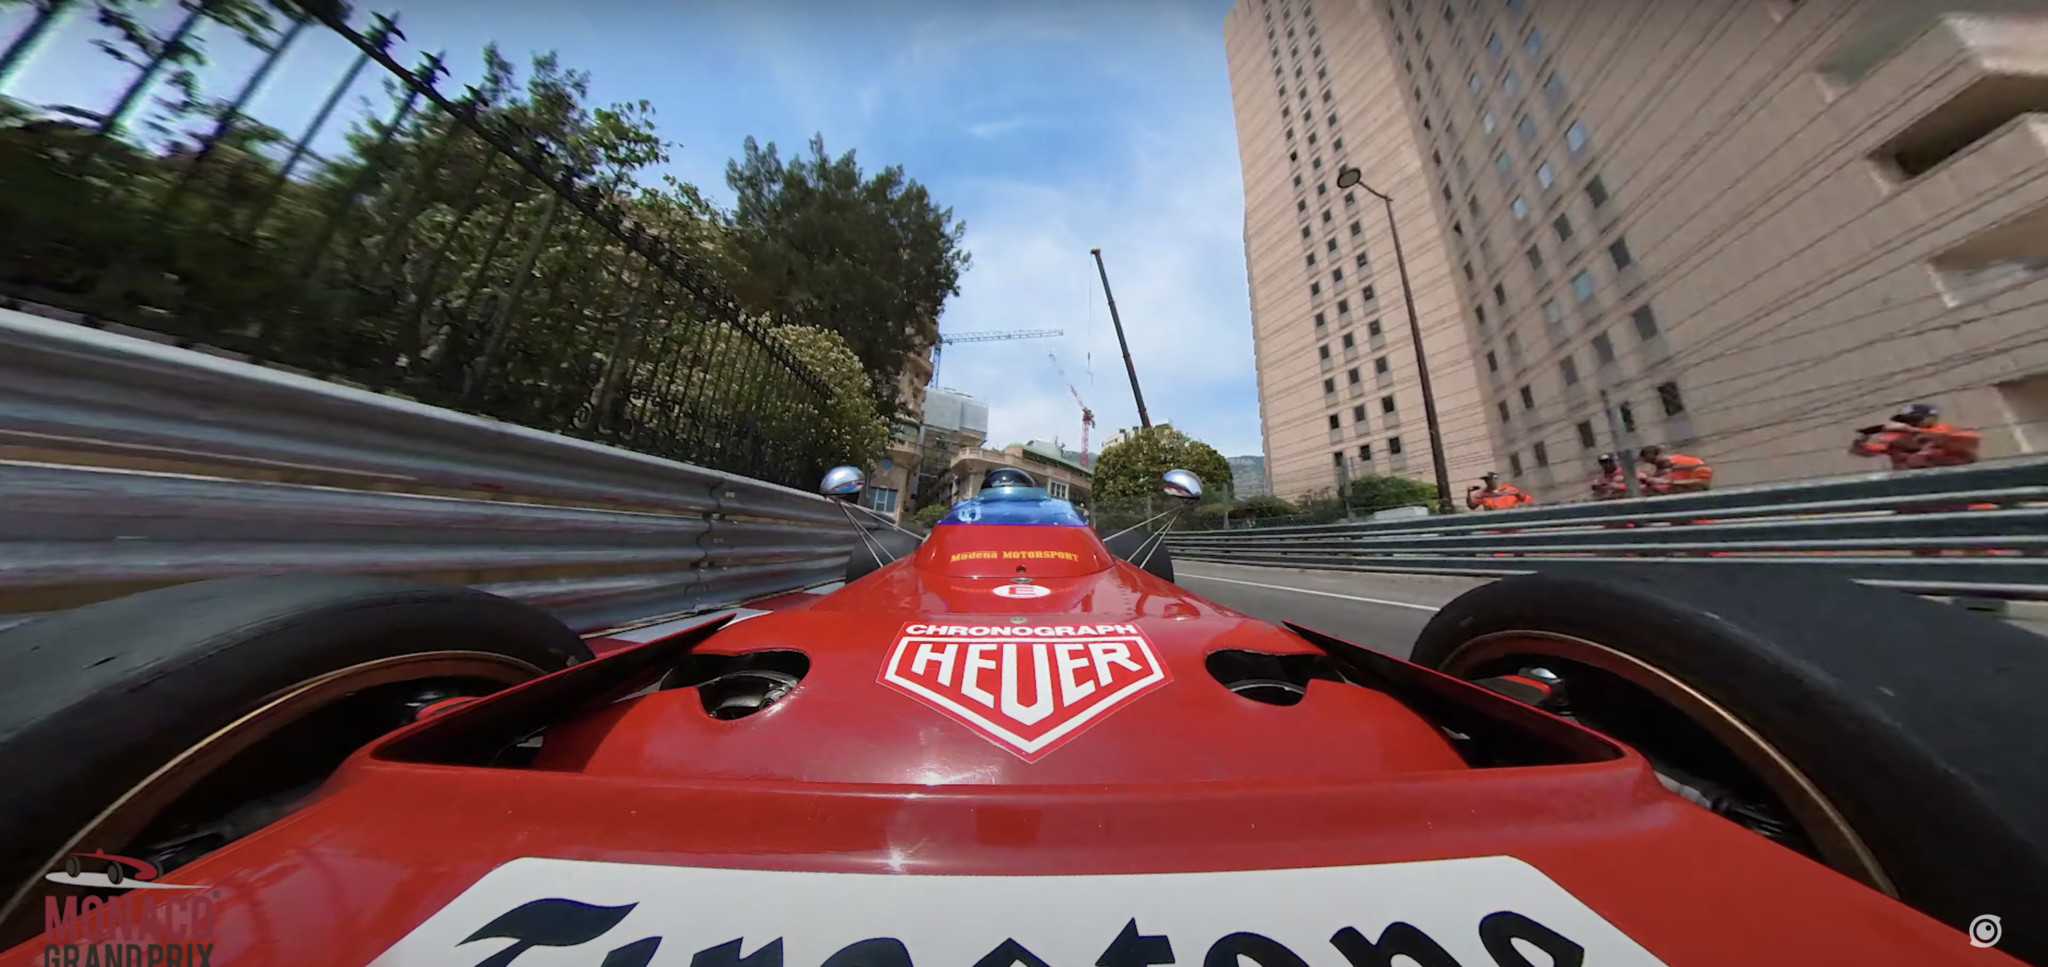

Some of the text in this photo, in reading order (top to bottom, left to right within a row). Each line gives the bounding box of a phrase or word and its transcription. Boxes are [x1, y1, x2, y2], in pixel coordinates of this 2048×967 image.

[950, 551, 1078, 562] Modena MOTORSPORT
[906, 624, 1137, 637] CHRONOGRAPH
[911, 643, 1143, 726] HEUER
